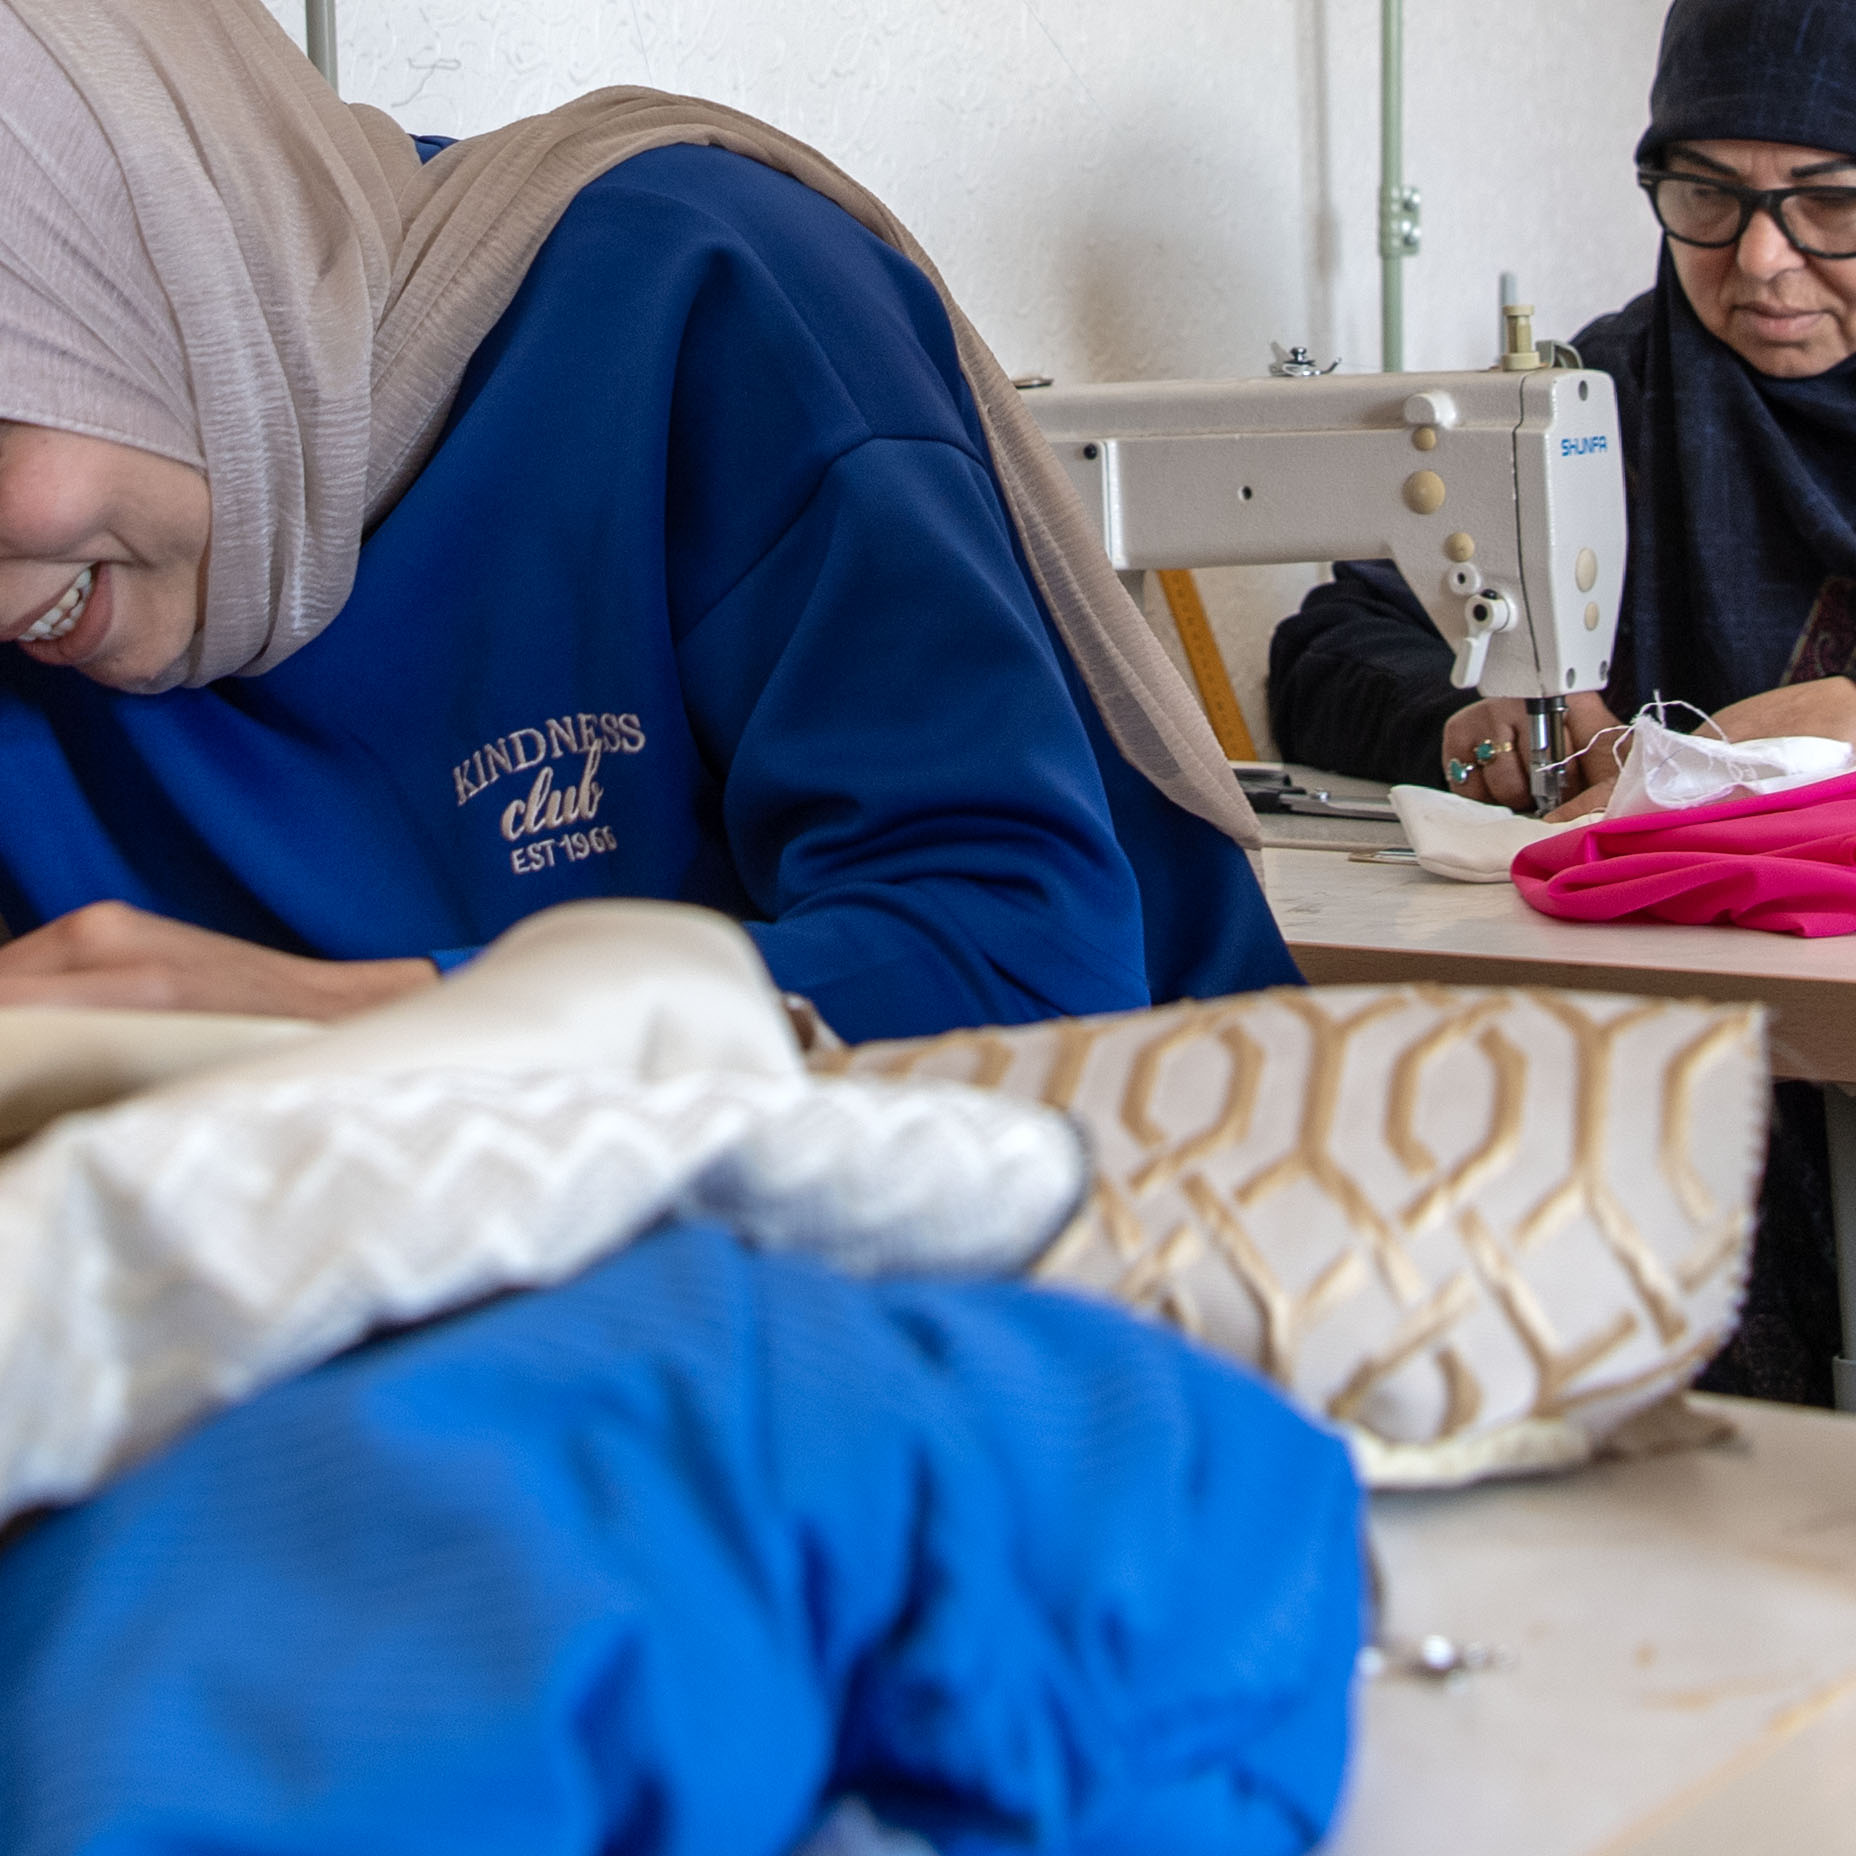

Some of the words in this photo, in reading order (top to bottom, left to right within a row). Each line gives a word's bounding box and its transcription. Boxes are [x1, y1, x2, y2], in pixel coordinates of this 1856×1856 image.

[1561, 436, 1606, 457] SHUNFA
[452, 712, 646, 807] KINDNESS
[501, 739, 604, 842] club
[512, 839, 555, 874] EST
